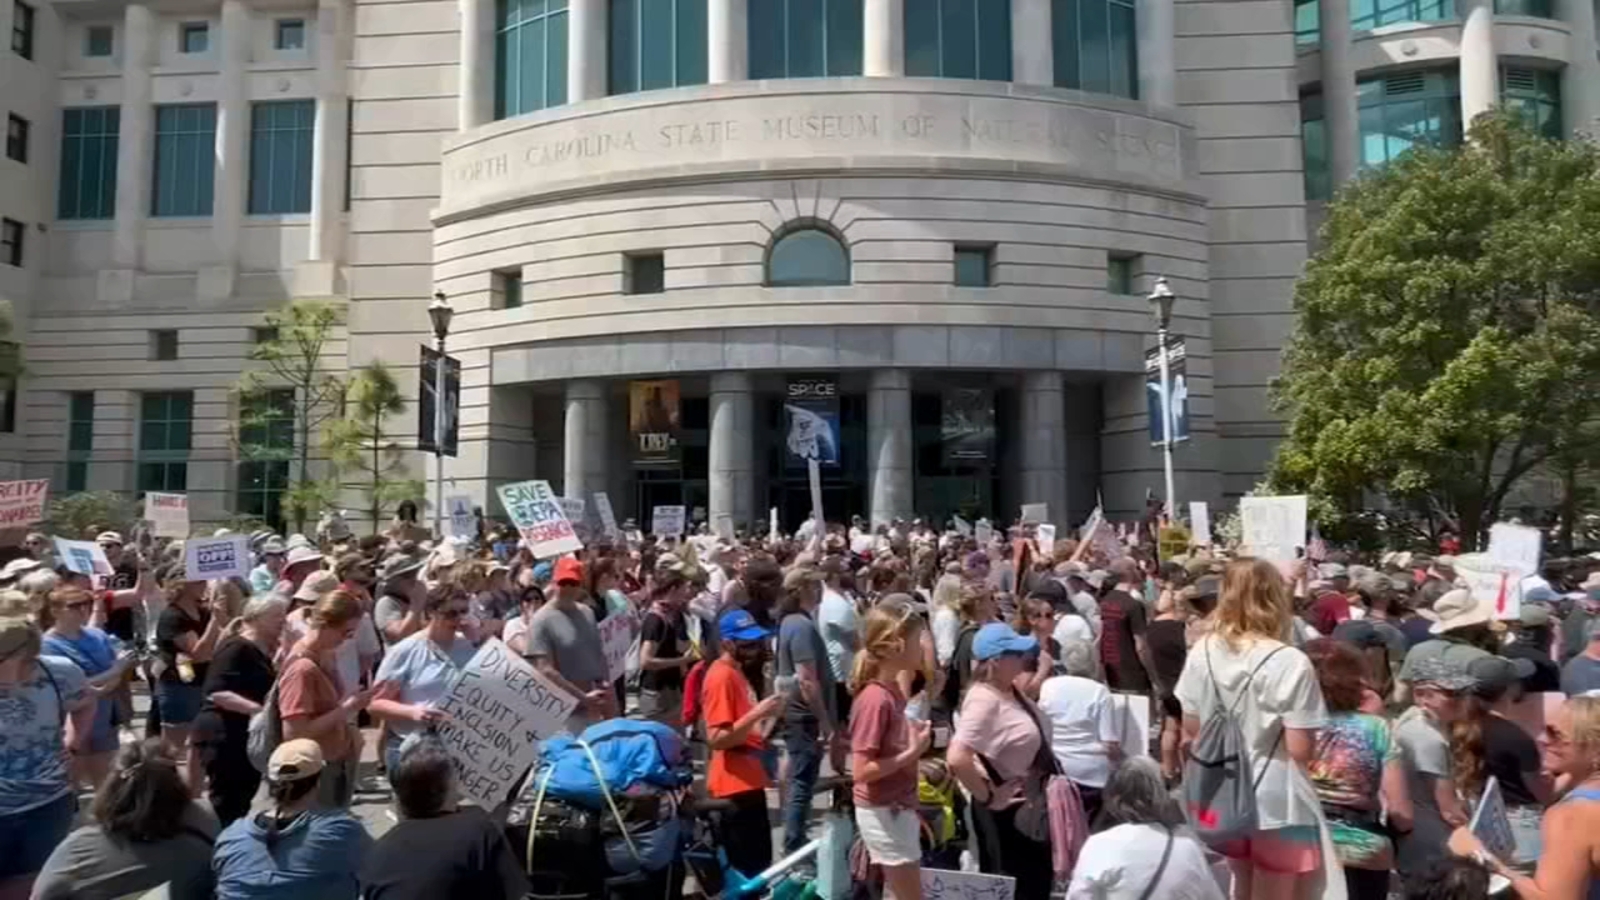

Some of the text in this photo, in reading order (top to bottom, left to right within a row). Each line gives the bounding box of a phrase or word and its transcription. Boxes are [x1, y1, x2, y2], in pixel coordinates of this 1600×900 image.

[524, 132, 637, 168] CAROLINA
[659, 119, 739, 147] STATE
[763, 115, 879, 141] MUSEUM
[901, 115, 936, 138] OF
[788, 383, 835, 396] SPACE
[504, 483, 549, 505] SAVE
[529, 500, 562, 522] EPA
[452, 671, 524, 732] EQUITY
[479, 646, 572, 718] DIVERSITY
[440, 720, 516, 781] MAKE US
